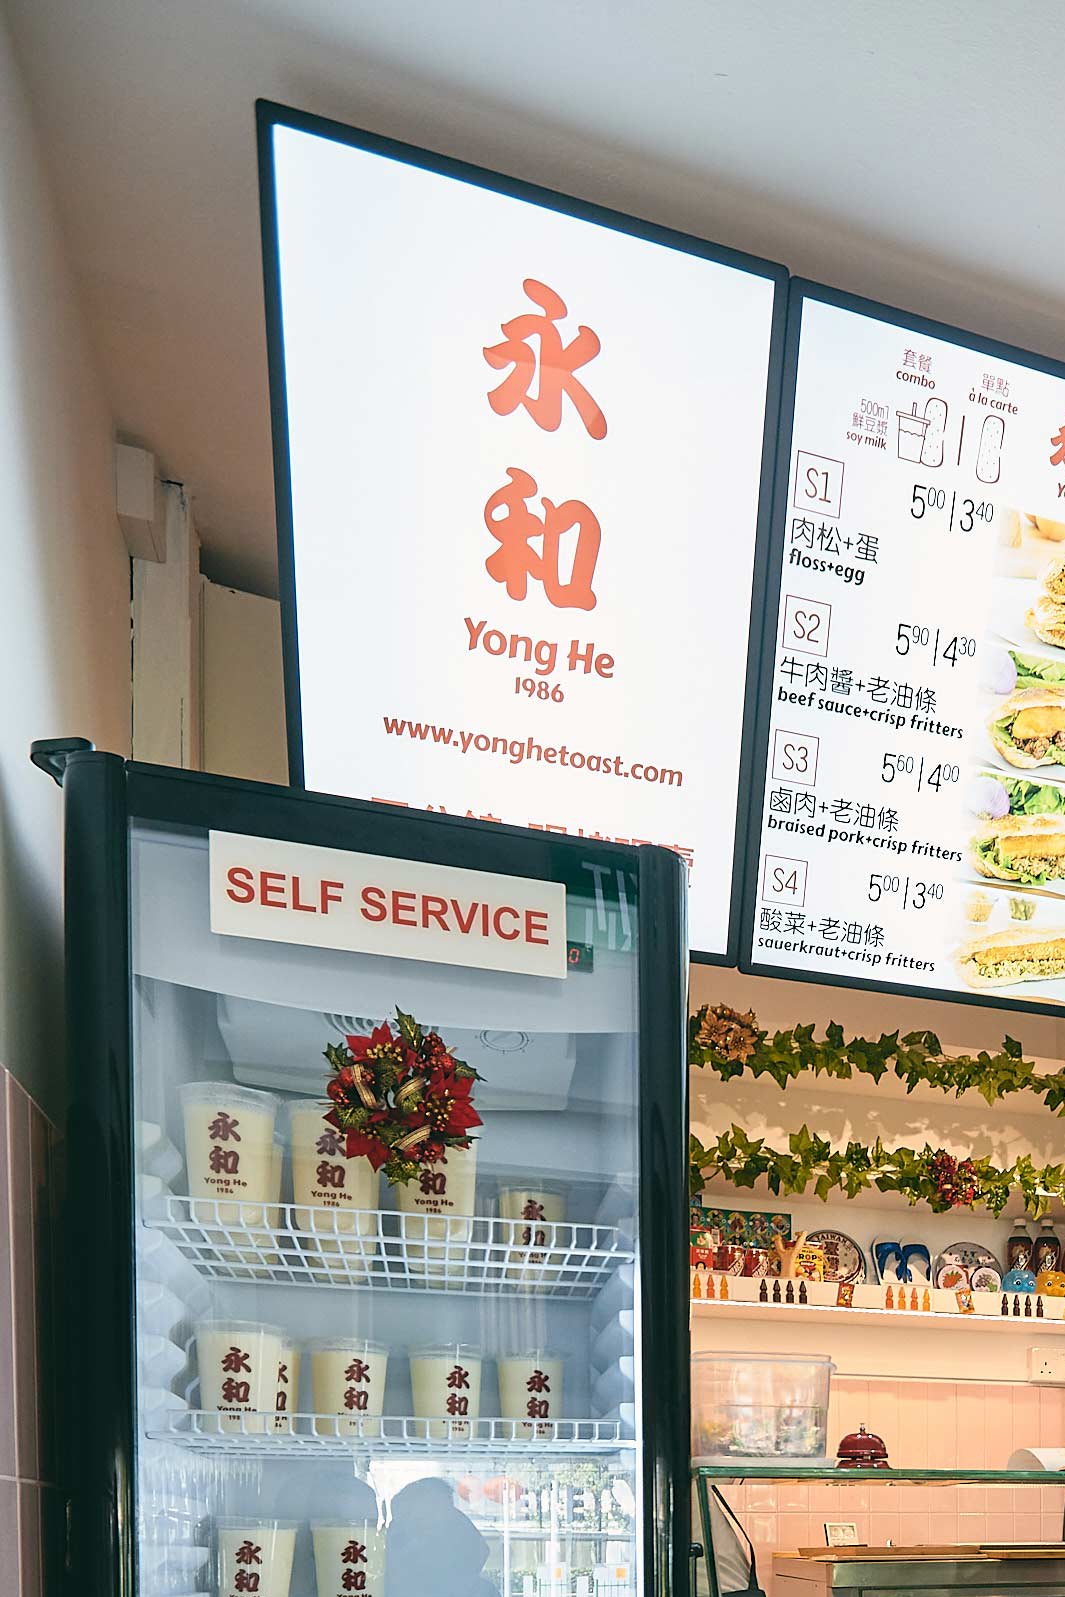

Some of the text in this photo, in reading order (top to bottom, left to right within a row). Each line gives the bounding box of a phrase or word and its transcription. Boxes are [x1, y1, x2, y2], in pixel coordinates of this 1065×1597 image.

[896, 368, 935, 389] combo
[903, 348, 934, 374] 套餐
[978, 390, 989, 405] la
[990, 398, 1018, 415] carte
[981, 373, 1010, 398] 單點
[861, 399, 889, 419] 500ml
[483, 279, 607, 610] 永和
[846, 429, 887, 450] soy milk
[805, 467, 831, 504] S1
[789, 548, 865, 585] floss+egg
[793, 609, 821, 644] S2
[463, 617, 615, 679] Yong He
[514, 676, 565, 703] 1986
[778, 687, 964, 739] beef sauce+crisp fritters
[383, 713, 684, 787] www.yonghetoast.com
[782, 744, 809, 773] S3
[768, 816, 963, 863] braised pork+crisp fritters
[772, 867, 798, 896] S4
[226, 866, 343, 915] SELF
[360, 886, 549, 944] SERVICE
[758, 936, 935, 973] sauerkraut+crisp fritters
[207, 1111, 241, 1175] 永和
[203, 1176, 247, 1189] Yong He
[221, 1346, 252, 1403] 永和
[344, 1358, 371, 1412] 永和
[526, 1369, 551, 1420] 永和
[235, 1540, 262, 1593] 永和
[341, 1540, 367, 1592] 永和
